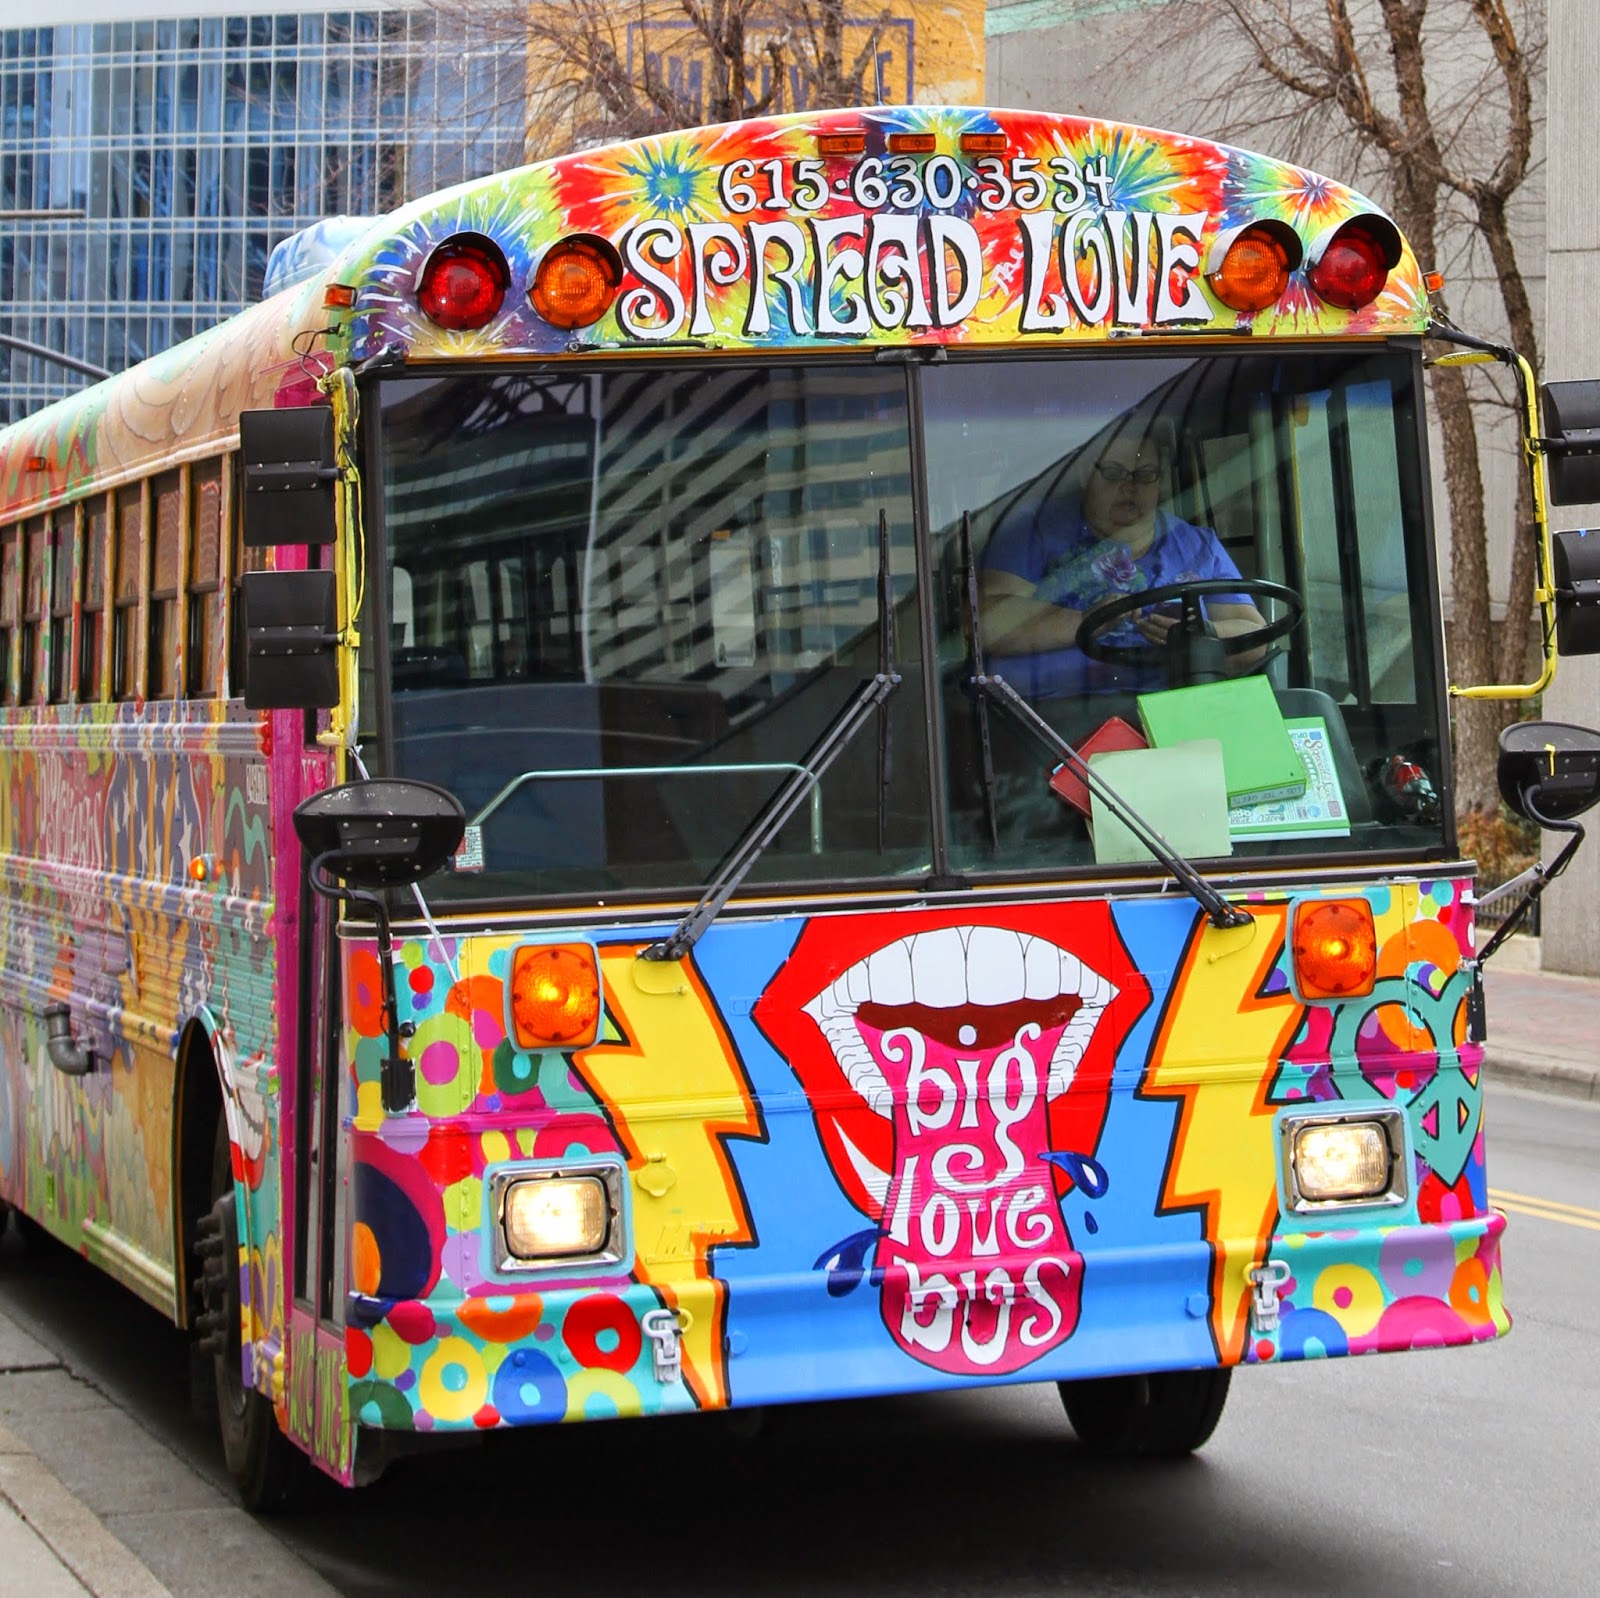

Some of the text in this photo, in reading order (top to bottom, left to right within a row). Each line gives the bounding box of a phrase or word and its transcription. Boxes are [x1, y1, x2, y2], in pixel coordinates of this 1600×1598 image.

[617, 213, 983, 338] SPREAD
[1016, 210, 1215, 333] LOVE
[879, 1022, 1042, 1192] big
[888, 1155, 1054, 1258] love
[892, 1255, 1070, 1365] bus
